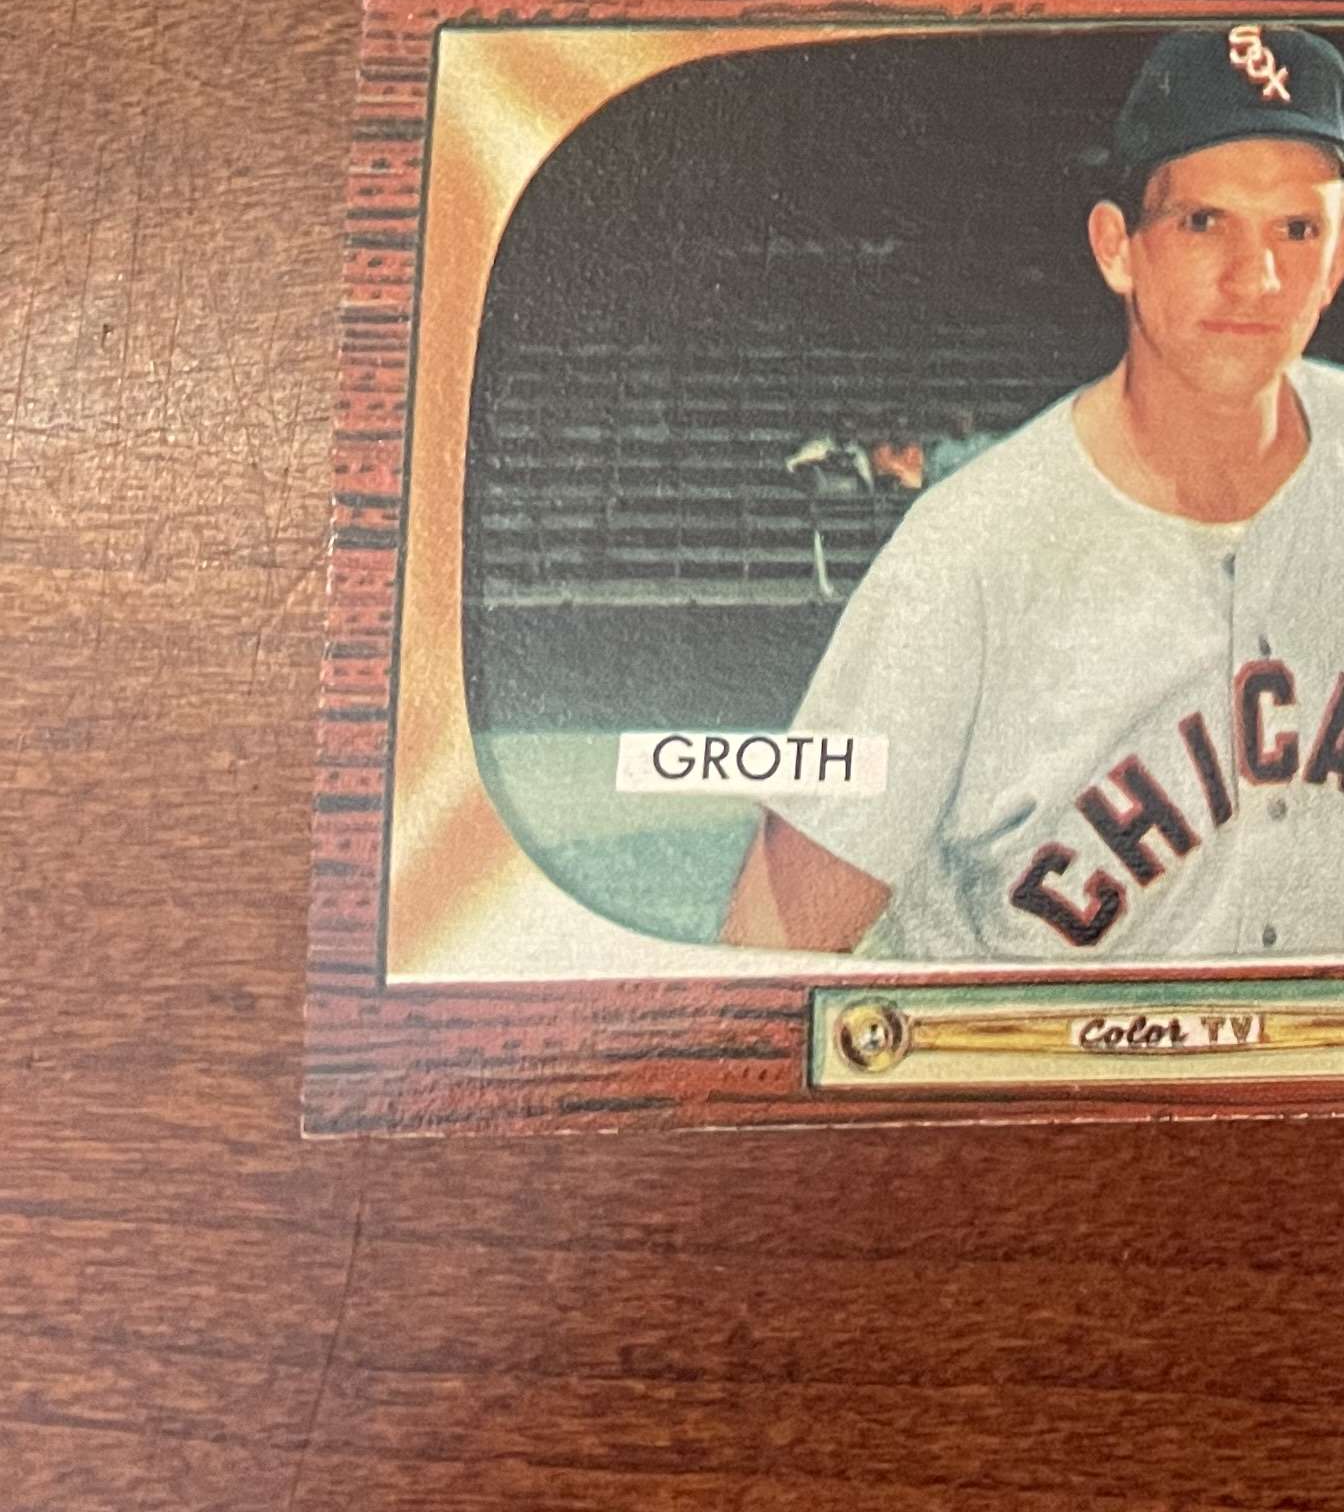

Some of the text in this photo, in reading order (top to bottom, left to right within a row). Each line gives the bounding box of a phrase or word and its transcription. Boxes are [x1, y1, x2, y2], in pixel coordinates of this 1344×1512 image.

[1228, 24, 1291, 102] SOX
[653, 735, 854, 781] GROTH
[1079, 1015, 1253, 1049] Color TV
